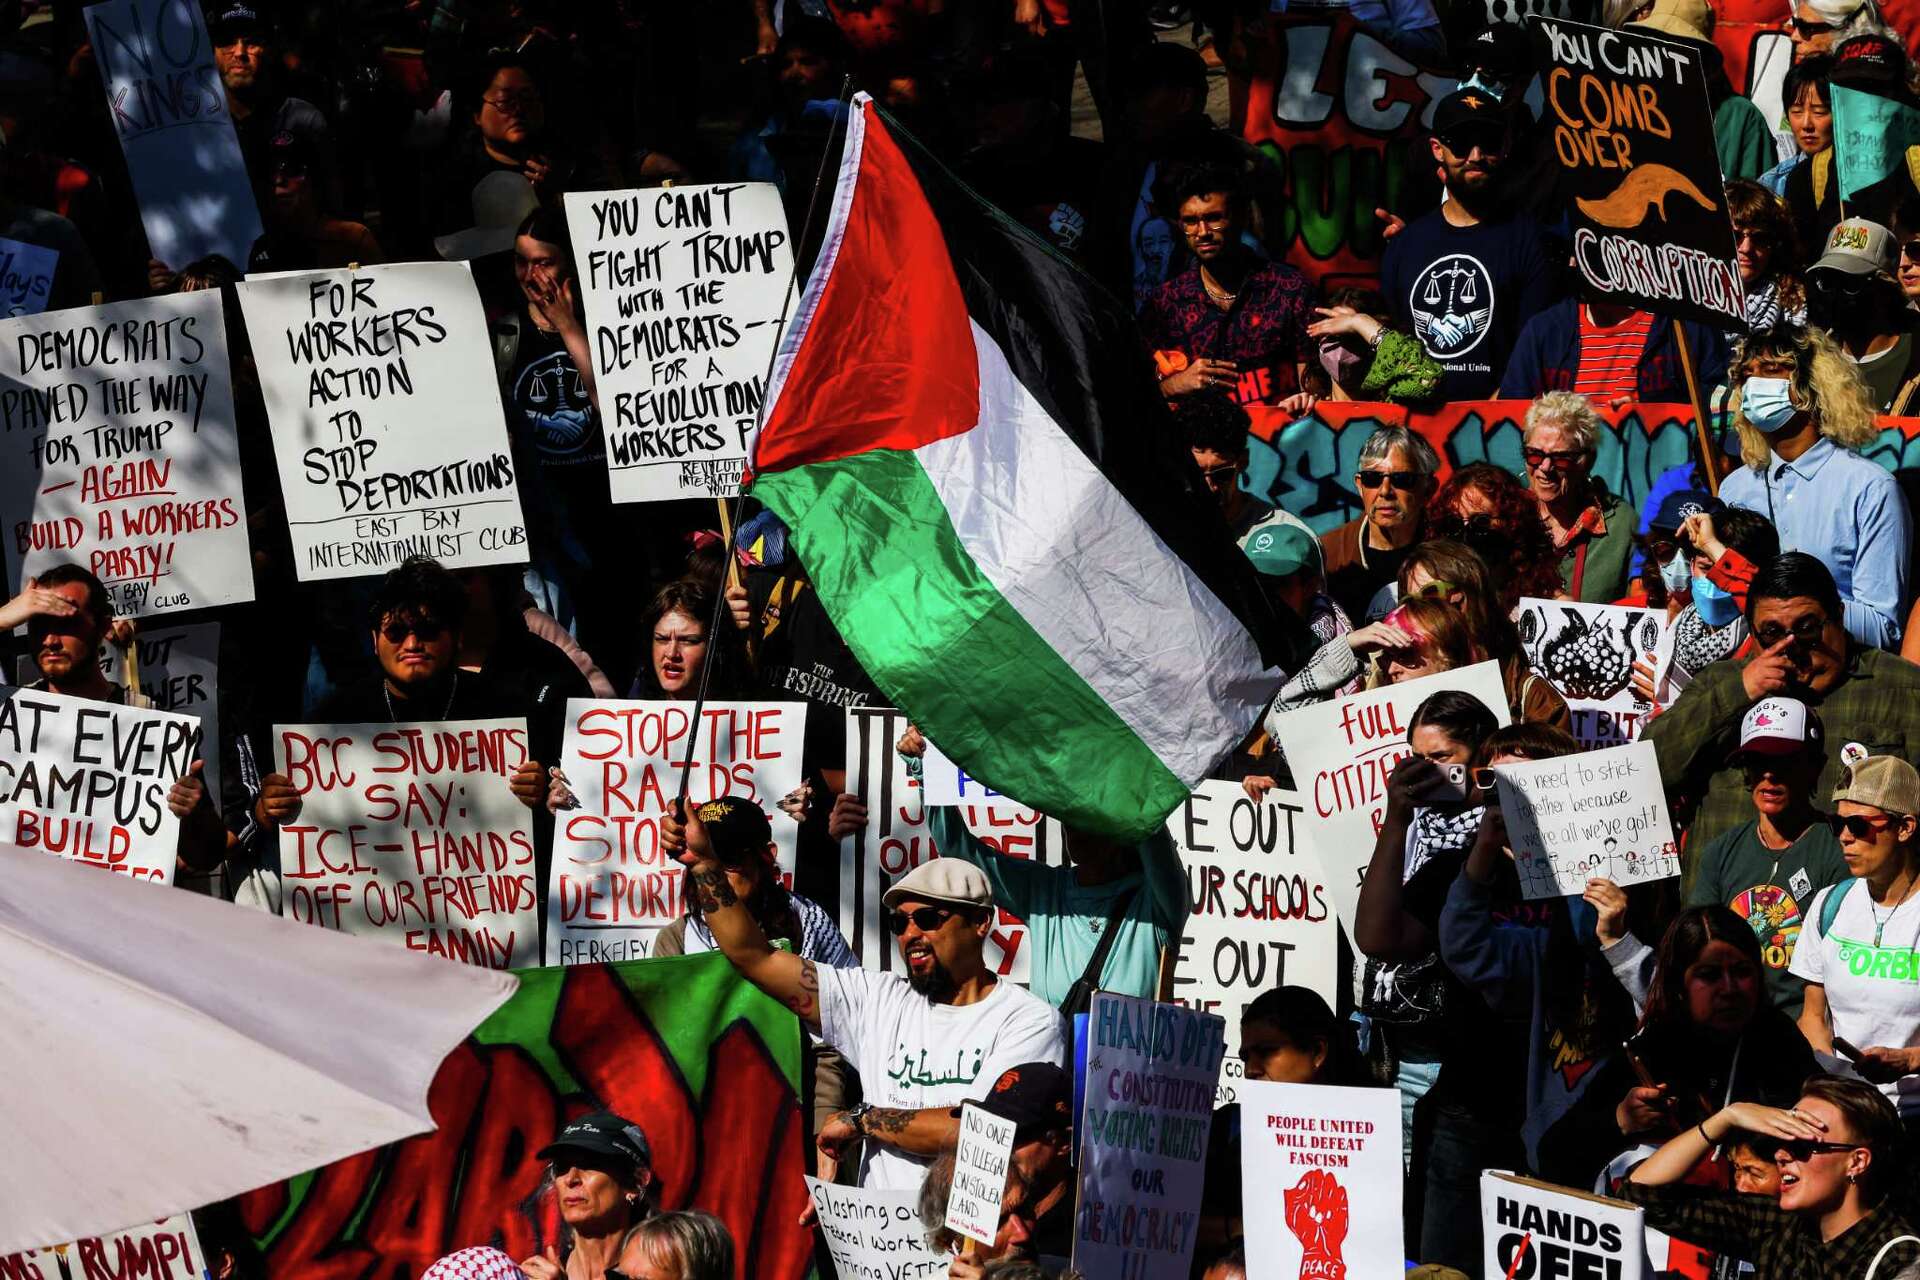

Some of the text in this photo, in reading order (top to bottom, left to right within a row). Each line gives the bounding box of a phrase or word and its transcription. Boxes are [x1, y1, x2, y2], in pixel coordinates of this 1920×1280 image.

[1541, 22, 1690, 85] YOU CAN'T
[1549, 67, 1672, 140] COMB
[1554, 124, 1633, 169] OVER
[591, 184, 746, 241] YOU CAN'T
[588, 230, 785, 289] FIGHT TRUMP
[1574, 227, 1748, 321] CORRUPTION
[309, 277, 378, 318] FOR
[617, 280, 726, 319] WITH THE
[18, 316, 204, 375] DEMOCRATS
[287, 306, 447, 364] WORKERS
[309, 357, 414, 408] ACTION
[651, 356, 724, 386] FOR A
[1, 373, 208, 432] PAVED THE WAY
[328, 410, 362, 442] TO
[29, 420, 173, 469] FOR TRUMP
[303, 439, 378, 485] STOP
[609, 422, 726, 466] WORKERS
[335, 453, 513, 512] DEPORTATIONS
[15, 498, 239, 554] BUILD A WORKERS
[355, 508, 461, 539] EAST BAY
[90, 542, 175, 587] PARTY!
[308, 526, 526, 571] INTERNATIONALIST CLUB
[124, 582, 150, 606] BAY
[155, 593, 190, 609] CLUB
[73, 708, 203, 783] EVERY
[576, 708, 782, 763] STOP THE
[1338, 702, 1406, 745] FULL
[282, 729, 527, 796] BCC STUDENTS
[1505, 757, 1639, 794] We need to stick
[0, 760, 164, 836] CAMPUS
[364, 781, 467, 829] SAY:
[1516, 788, 1632, 822] together because
[15, 810, 131, 864] BUILD
[1230, 798, 1303, 855] OUT
[1561, 821, 1577, 844] all
[1580, 816, 1621, 842] we've
[1627, 804, 1657, 844] got!
[411, 830, 534, 876] HANDS
[292, 874, 536, 930] OFF OUR FRIENDS
[1234, 869, 1328, 923] SCHOOLS
[1213, 936, 1296, 989] OUT
[1098, 999, 1224, 1072] HANDS OFF
[887, 1042, 982, 1090] فلسطين
[1089, 1055, 1103, 1074] THE
[965, 1111, 1012, 1148] NO ONE
[1089, 1107, 1207, 1163] VOTING RIGHTS
[1267, 1115, 1375, 1135] PEOPLE UNITED
[1275, 1133, 1365, 1152] WILL DEFEAT
[960, 1138, 970, 1163] IS
[1289, 1151, 1349, 1168] FASCISM
[950, 1193, 979, 1218] LAND
[1131, 1168, 1165, 1196] OUR
[814, 1184, 888, 1230] Slashing
[1080, 1200, 1196, 1255] DEMOCRACY
[1496, 1196, 1623, 1253] HANDS
[1301, 1258, 1340, 1279] PEACE
